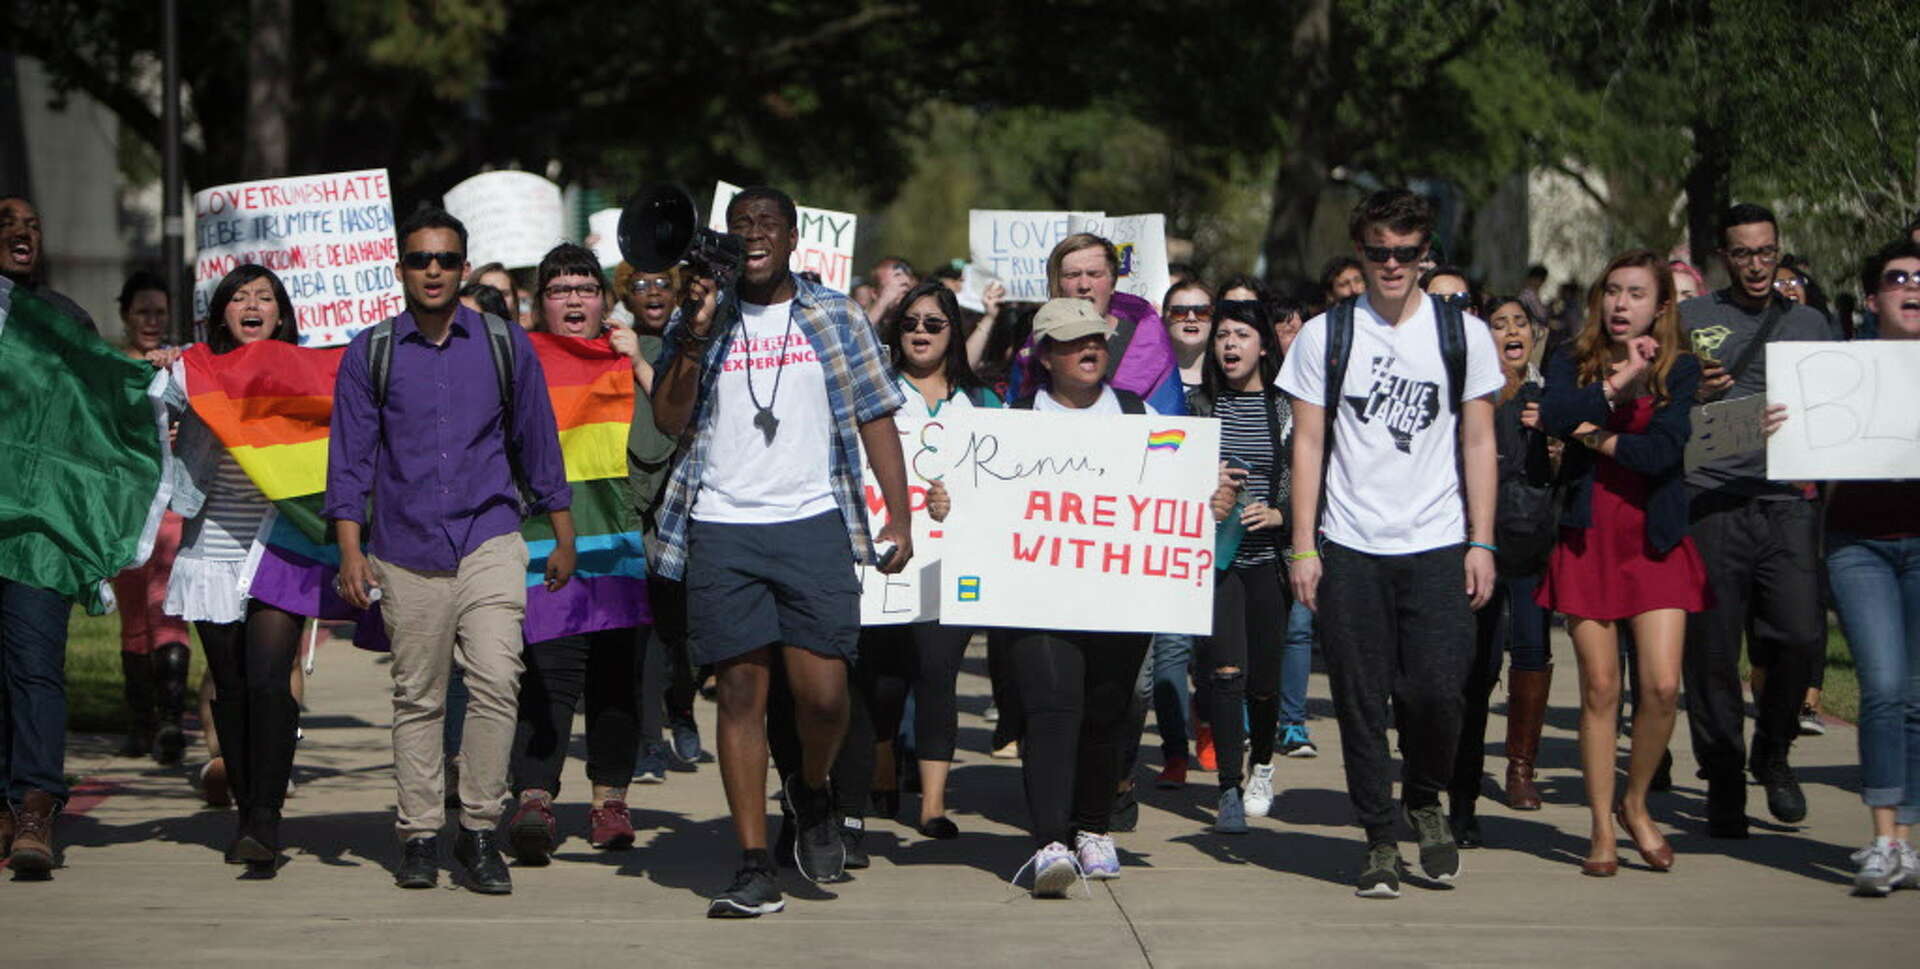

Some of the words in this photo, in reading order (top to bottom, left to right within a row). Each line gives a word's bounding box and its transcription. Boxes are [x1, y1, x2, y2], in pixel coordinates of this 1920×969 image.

[196, 186, 258, 219] LOVE
[322, 174, 389, 203] HATE
[800, 212, 851, 248] MY
[355, 265, 394, 293] ODIO
[1362, 391, 1430, 436] LARGE
[1023, 490, 1118, 527] ARE
[1127, 494, 1205, 539] YOU
[1012, 532, 1131, 575] WITH
[1142, 544, 1213, 588] US?
